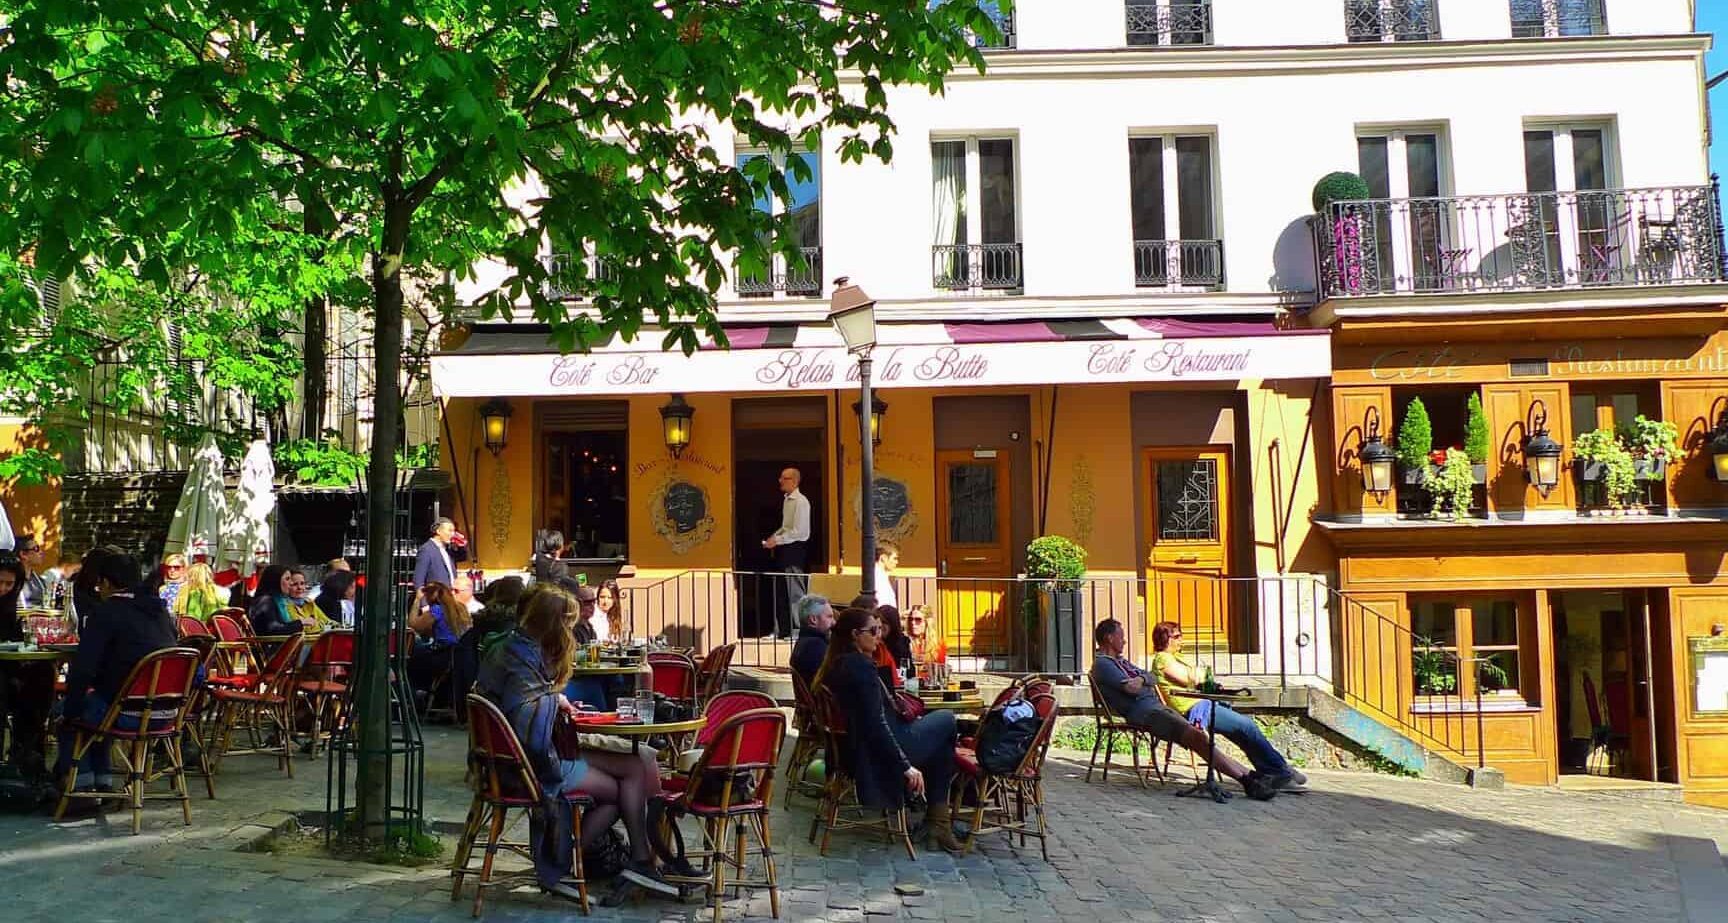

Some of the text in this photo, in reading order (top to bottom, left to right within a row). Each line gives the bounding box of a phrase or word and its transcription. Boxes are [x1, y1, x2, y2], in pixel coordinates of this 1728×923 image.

[607, 355, 659, 385] Bar
[756, 350, 834, 388] Relais
[881, 348, 904, 381] la
[913, 346, 987, 380] Butte
[1087, 342, 1251, 376] Coté Restaurant
